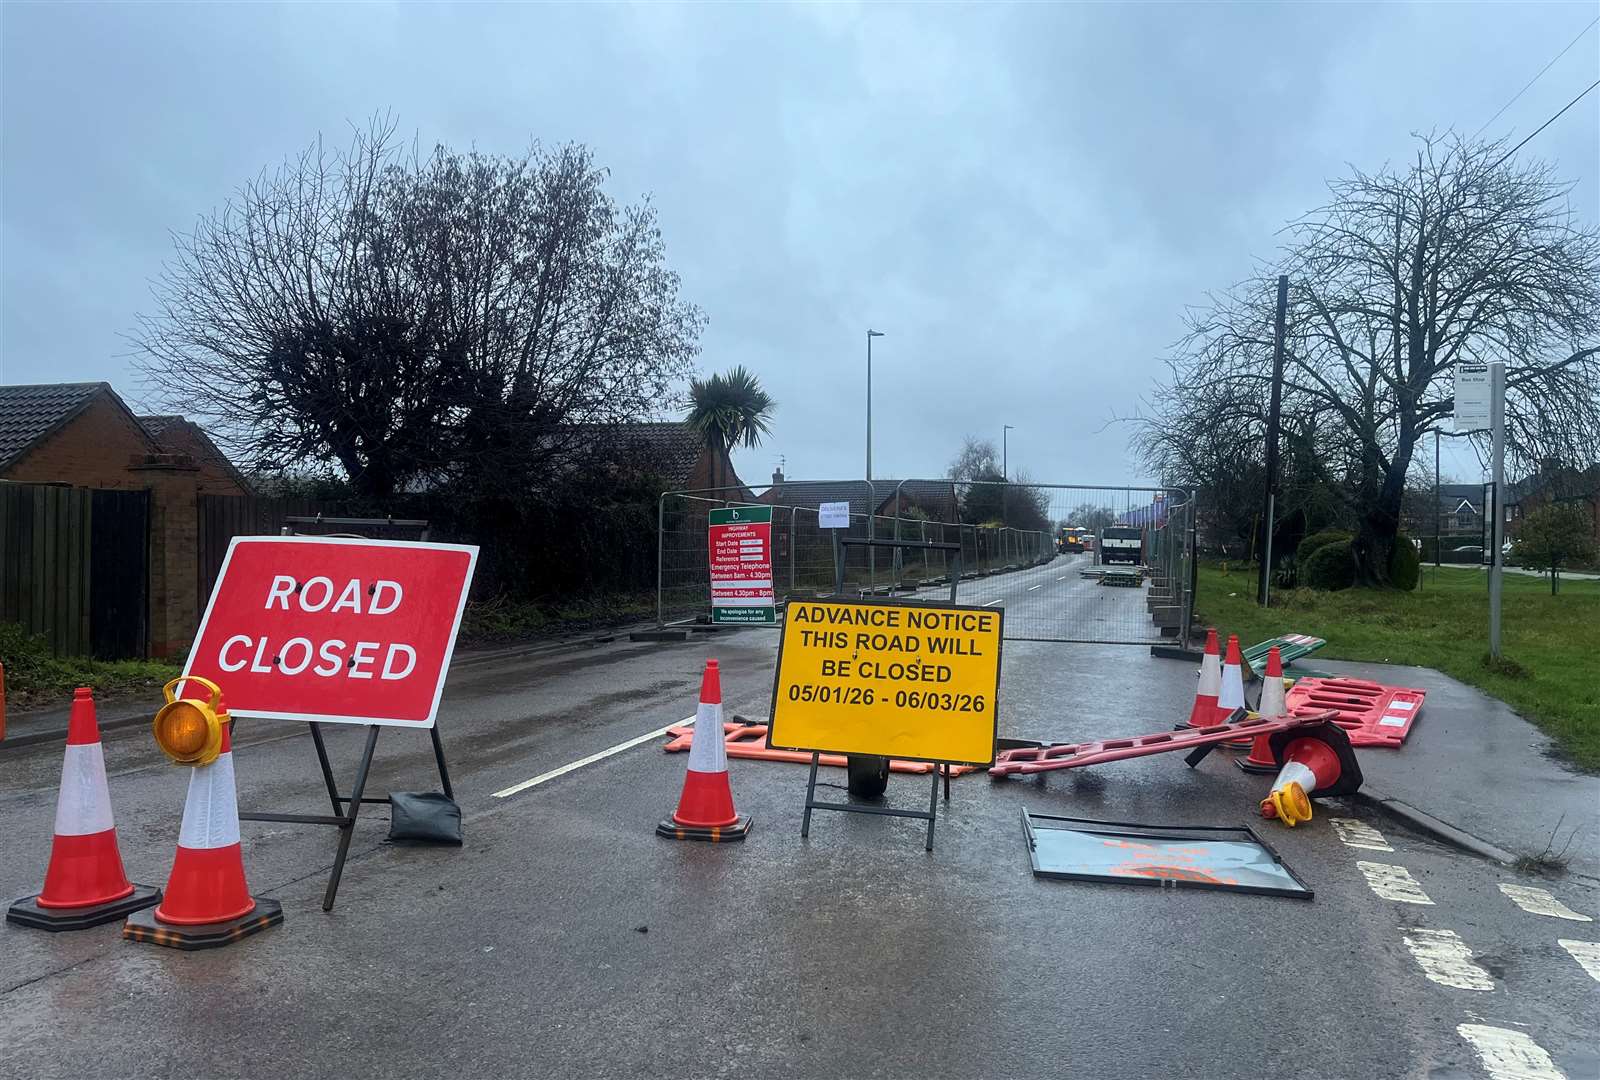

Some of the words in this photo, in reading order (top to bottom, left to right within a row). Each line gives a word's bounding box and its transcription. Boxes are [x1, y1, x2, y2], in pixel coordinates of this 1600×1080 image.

[741, 562, 770, 570] Telephone
[750, 572, 771, 580] 4.30pm
[265, 575, 403, 615] ROAD
[794, 606, 900, 627] ADVANCE
[907, 612, 992, 632] NOTICE
[800, 630, 848, 649] THIS
[856, 634, 920, 652] ROAD
[927, 637, 982, 656] WILL
[218, 635, 417, 681] CLOSED
[821, 660, 850, 677] BE
[858, 662, 951, 682] CLOSED
[789, 685, 874, 705] 05/01/26
[895, 691, 985, 712] 06/03/26
